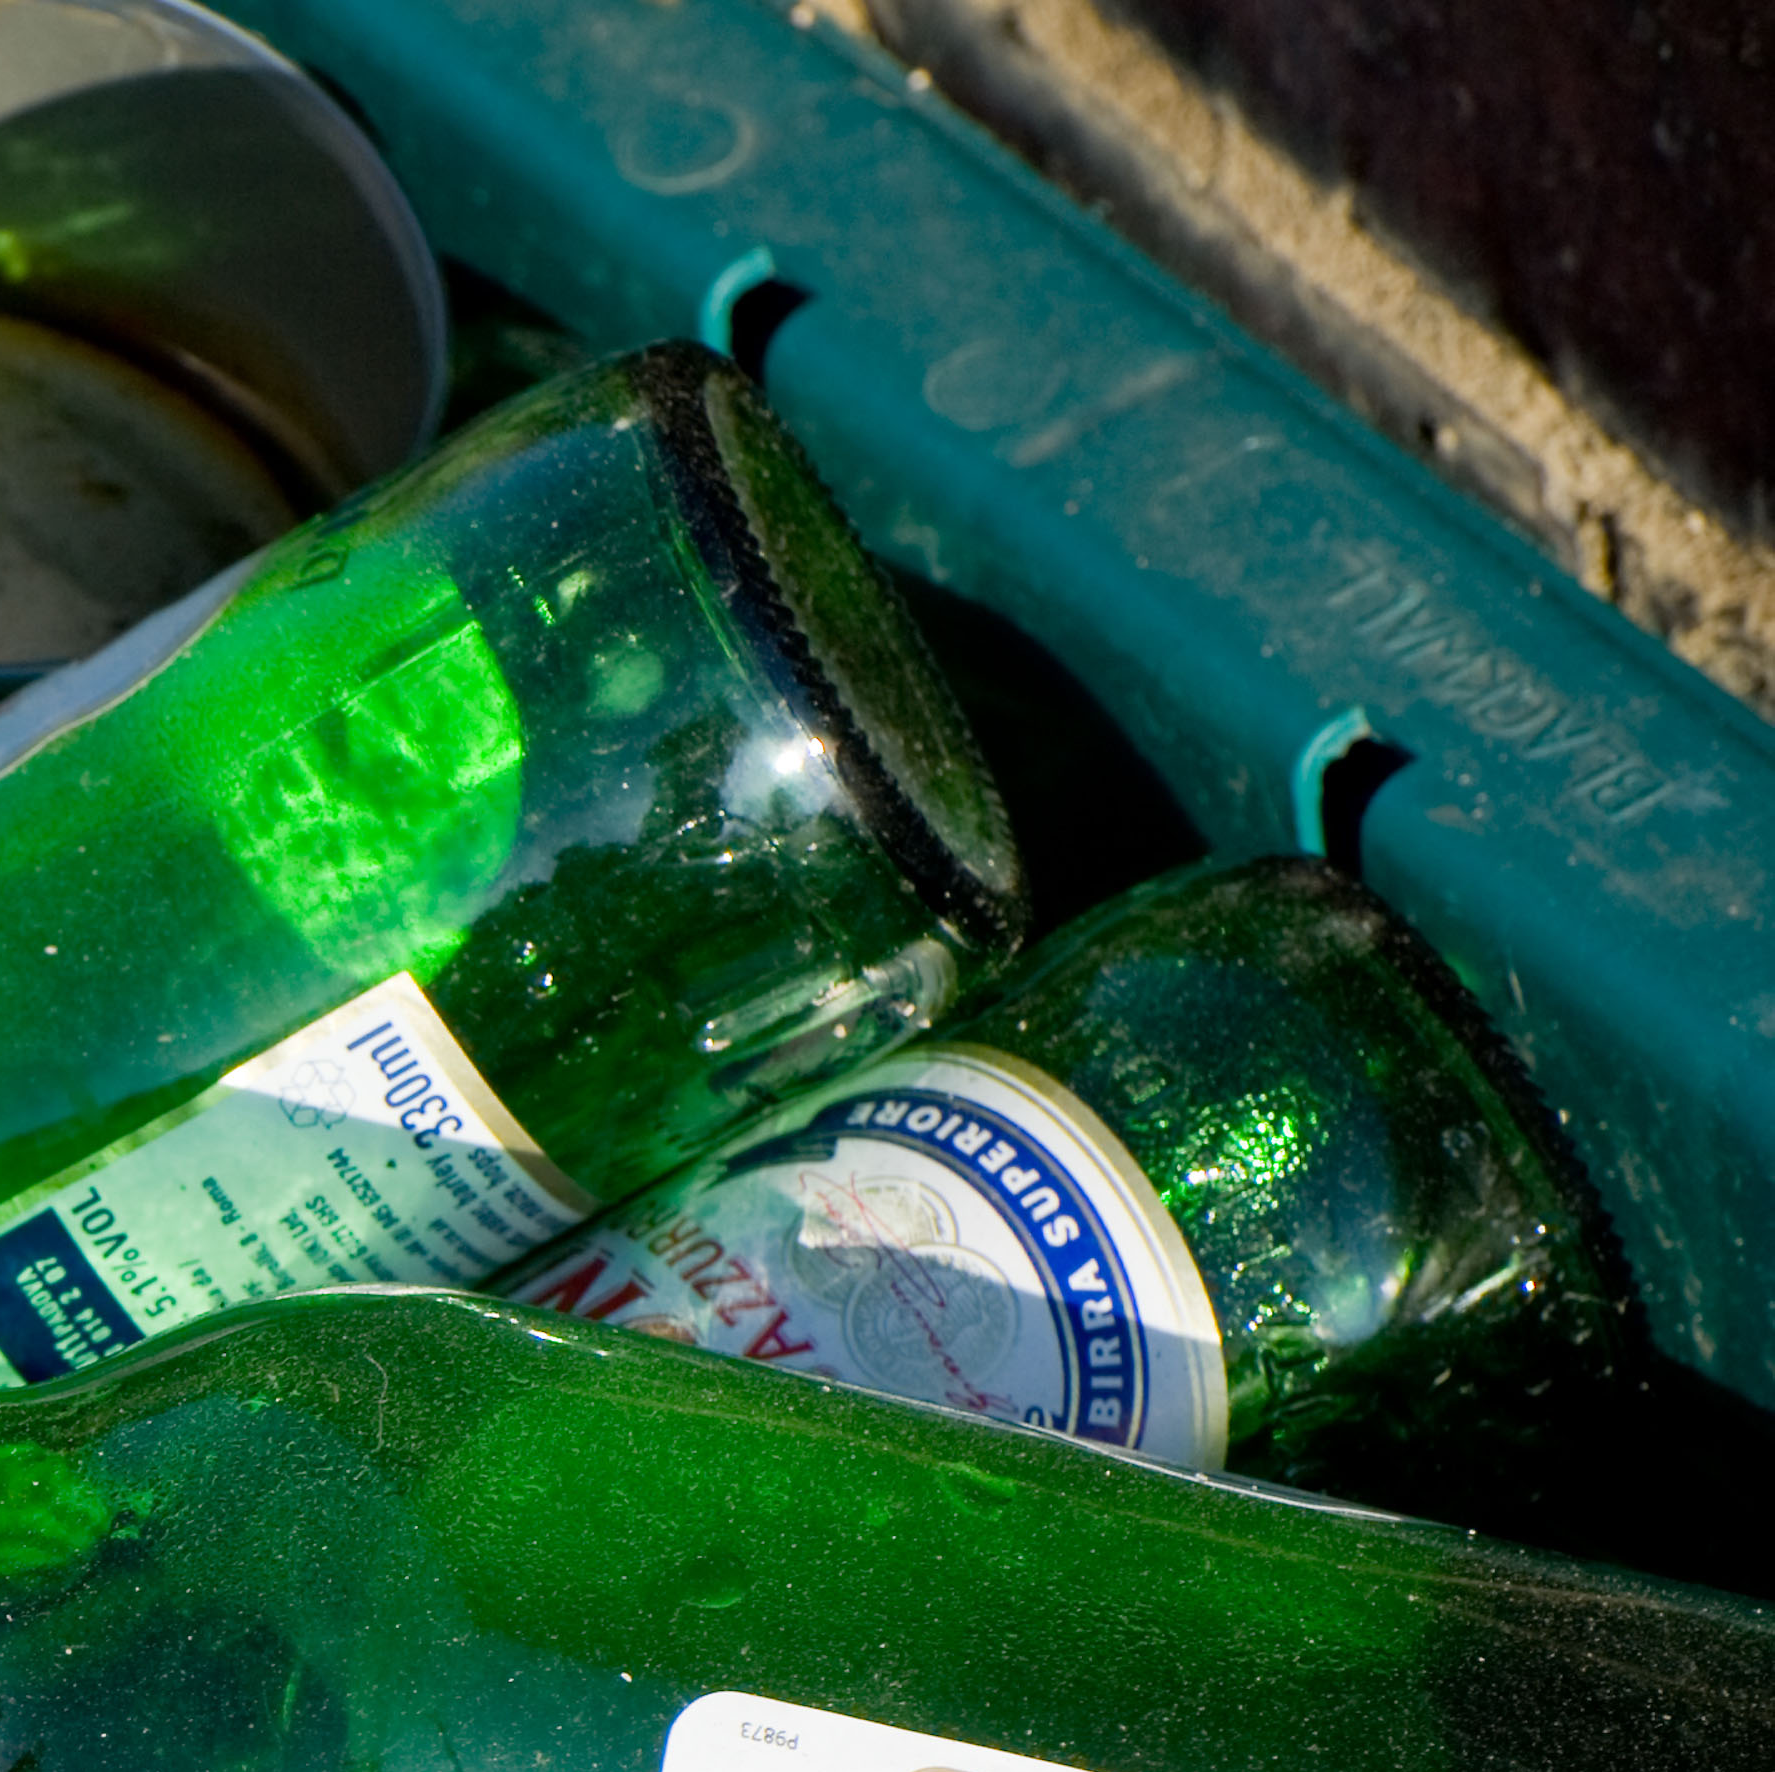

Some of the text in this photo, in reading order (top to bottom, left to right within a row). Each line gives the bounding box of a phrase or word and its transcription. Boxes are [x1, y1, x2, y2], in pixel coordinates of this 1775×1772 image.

[345, 1020, 464, 1151] 330ml
[201, 1175, 244, 1229] Roma
[426, 1152, 479, 1210] barley
[852, 1100, 1082, 1248] SUPERIORE
[1087, 1260, 1126, 1430] BIRRA
[740, 1720, 800, 1752] P9873
